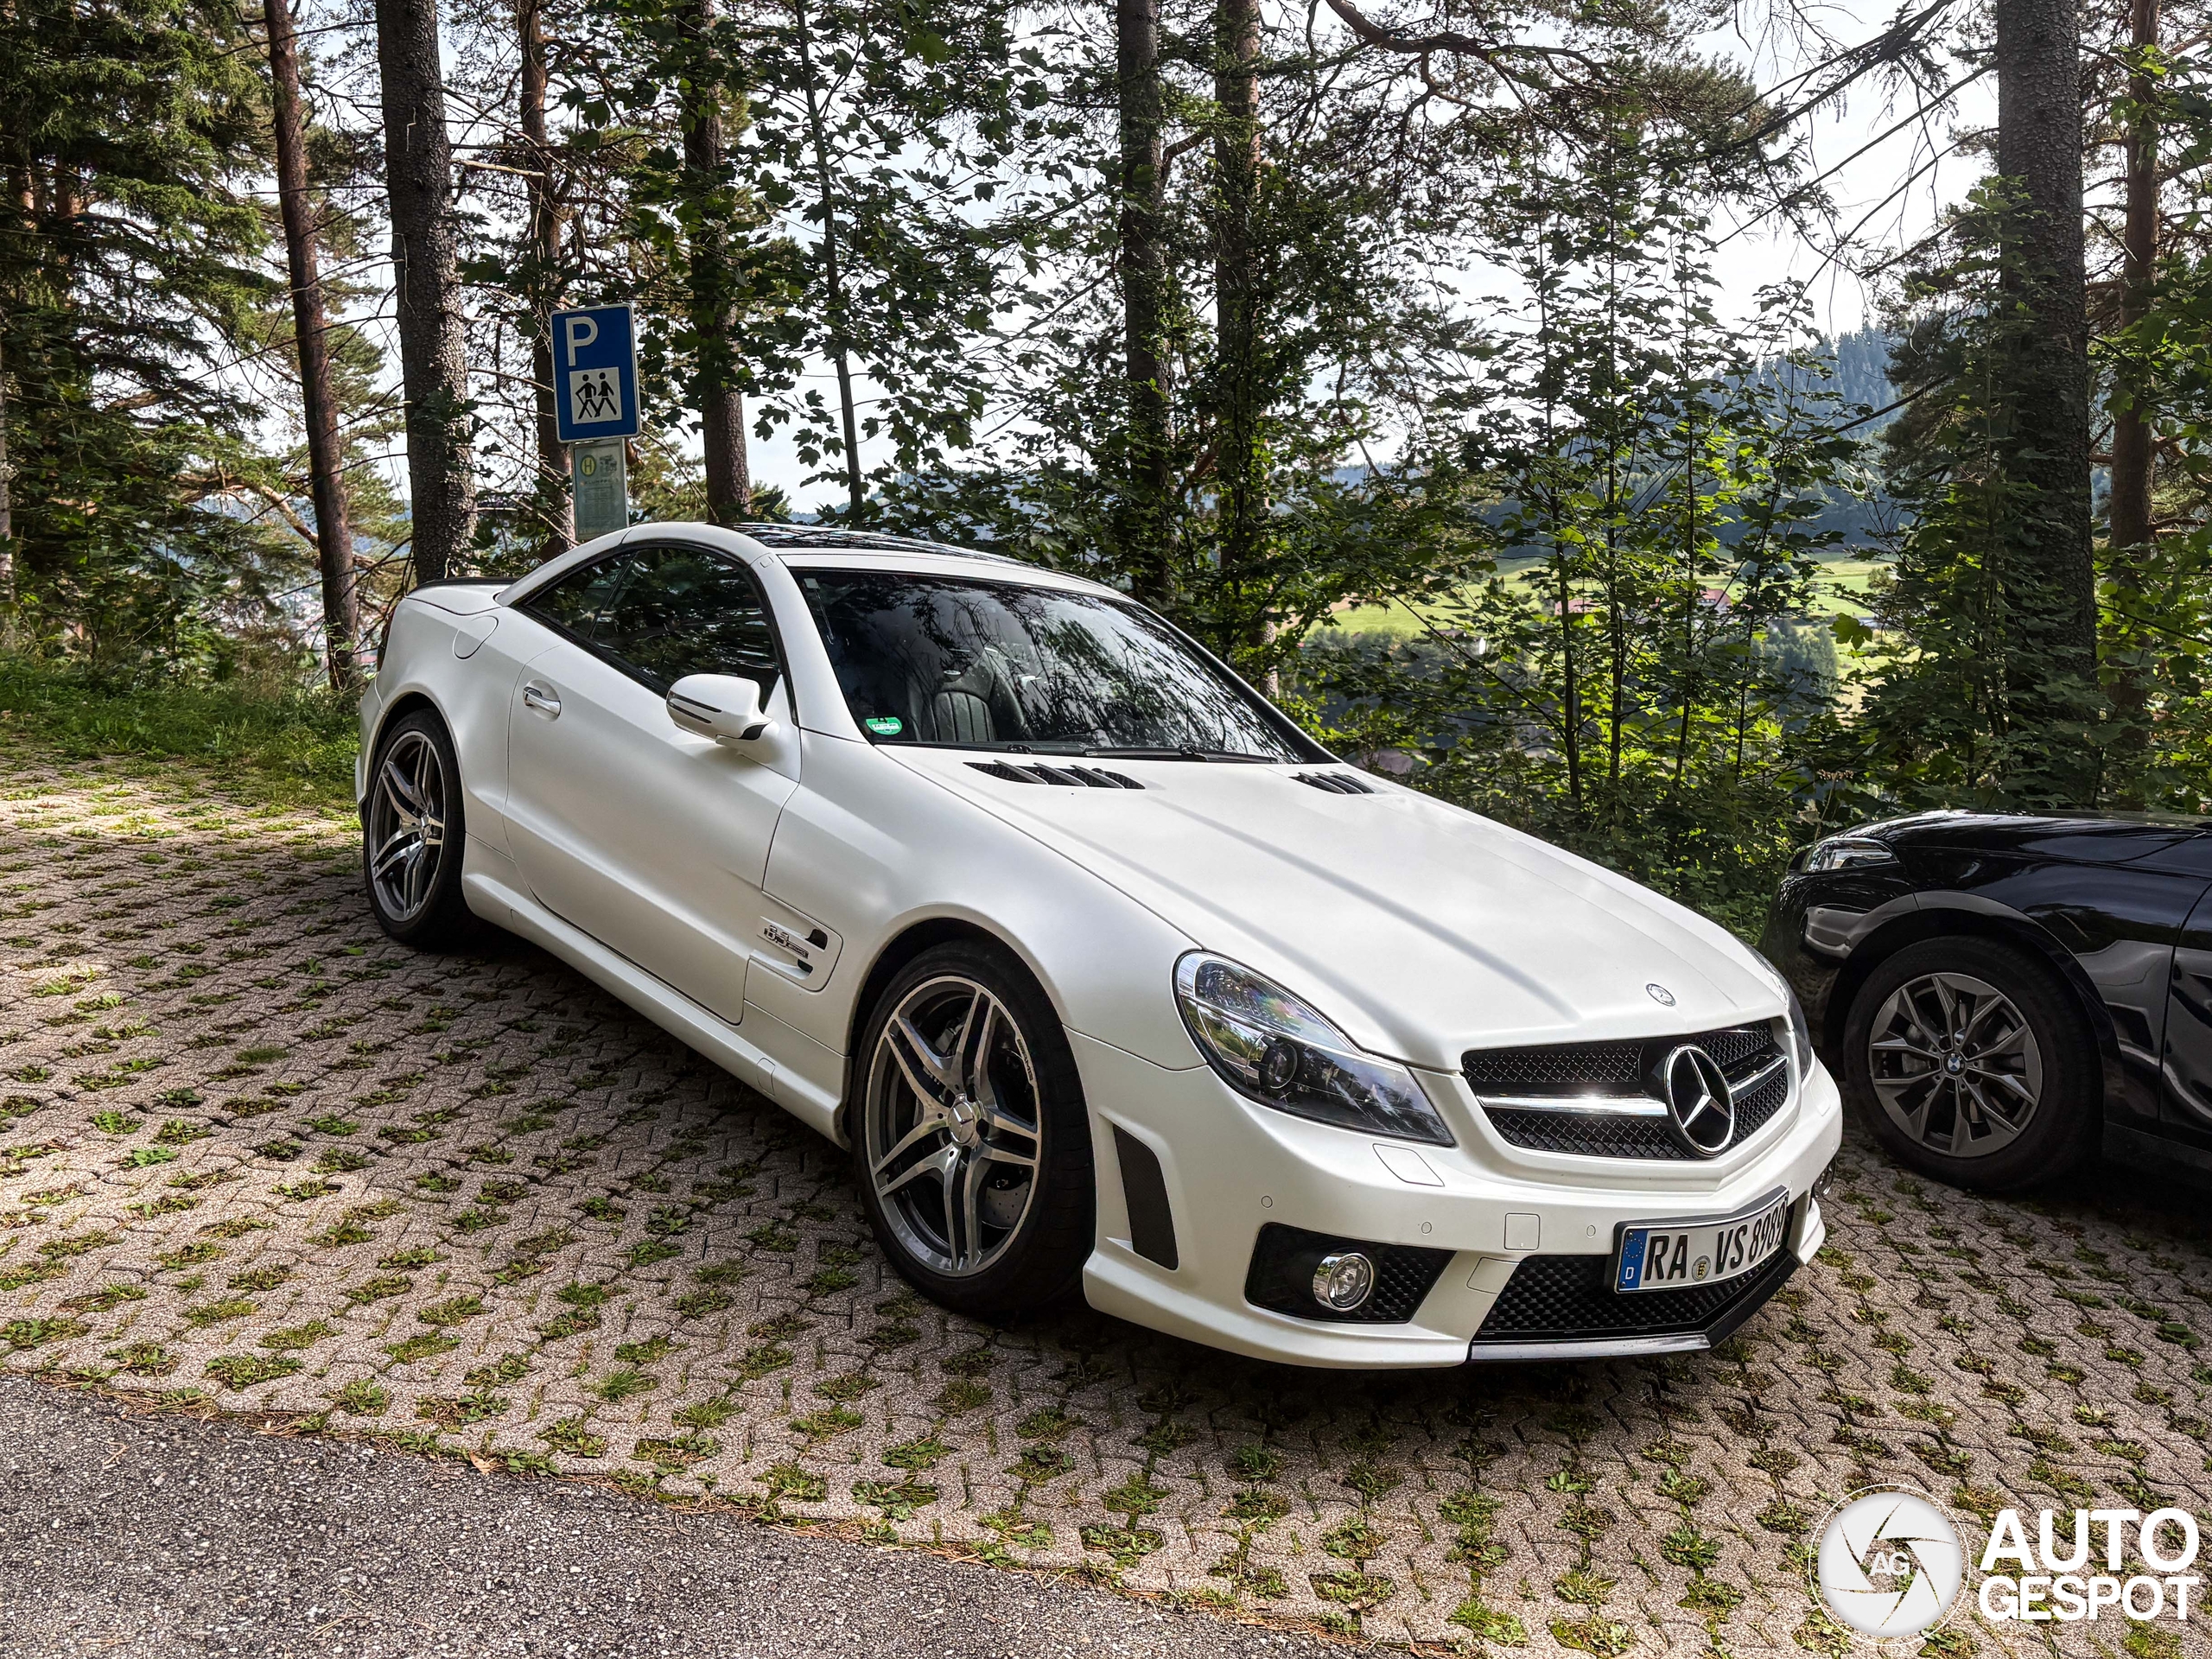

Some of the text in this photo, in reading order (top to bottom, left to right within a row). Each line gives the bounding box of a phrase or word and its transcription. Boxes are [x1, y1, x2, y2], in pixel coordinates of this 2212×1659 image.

[565, 315, 599, 366] P
[1644, 1201, 1786, 1281] RA VS 8989
[1624, 1267, 1635, 1280] D
